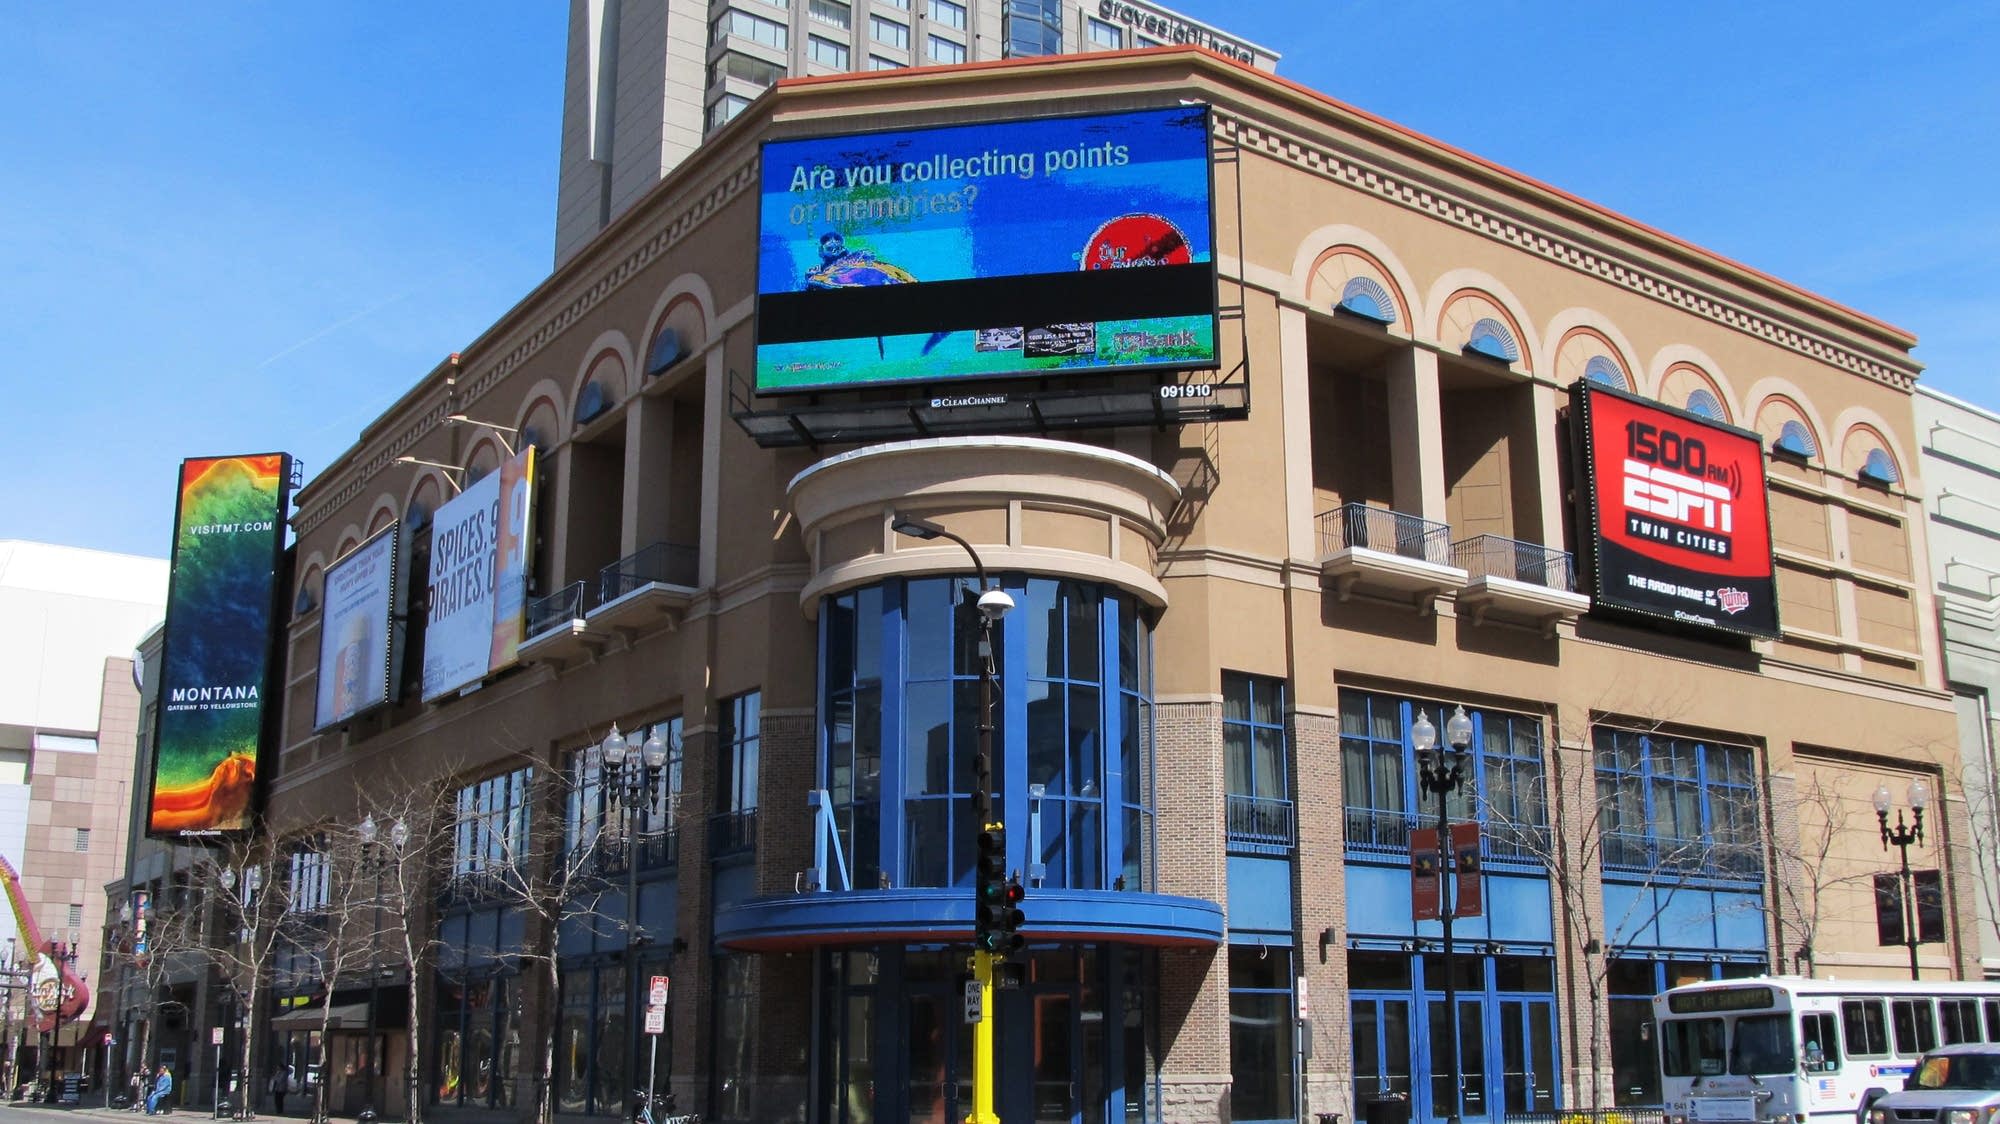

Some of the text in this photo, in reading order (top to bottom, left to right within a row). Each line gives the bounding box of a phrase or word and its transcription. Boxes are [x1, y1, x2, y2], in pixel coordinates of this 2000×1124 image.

[789, 141, 1129, 192] Are you collecting points
[789, 184, 979, 225] or memories?
[1160, 384, 1210, 398] 091910
[1625, 421, 1728, 483] 1500 AM
[1623, 458, 1732, 533] ESPN
[190, 521, 273, 535] VISITMT.COM
[1631, 519, 1727, 554] TWIN CITIES
[1627, 574, 1704, 601] THE RADIO HOME
[172, 685, 259, 702] MONTANA
[210, 701, 258, 710] YELLOWSTONE
[967, 983, 980, 994] ONE
[967, 994, 980, 1006] WAY
